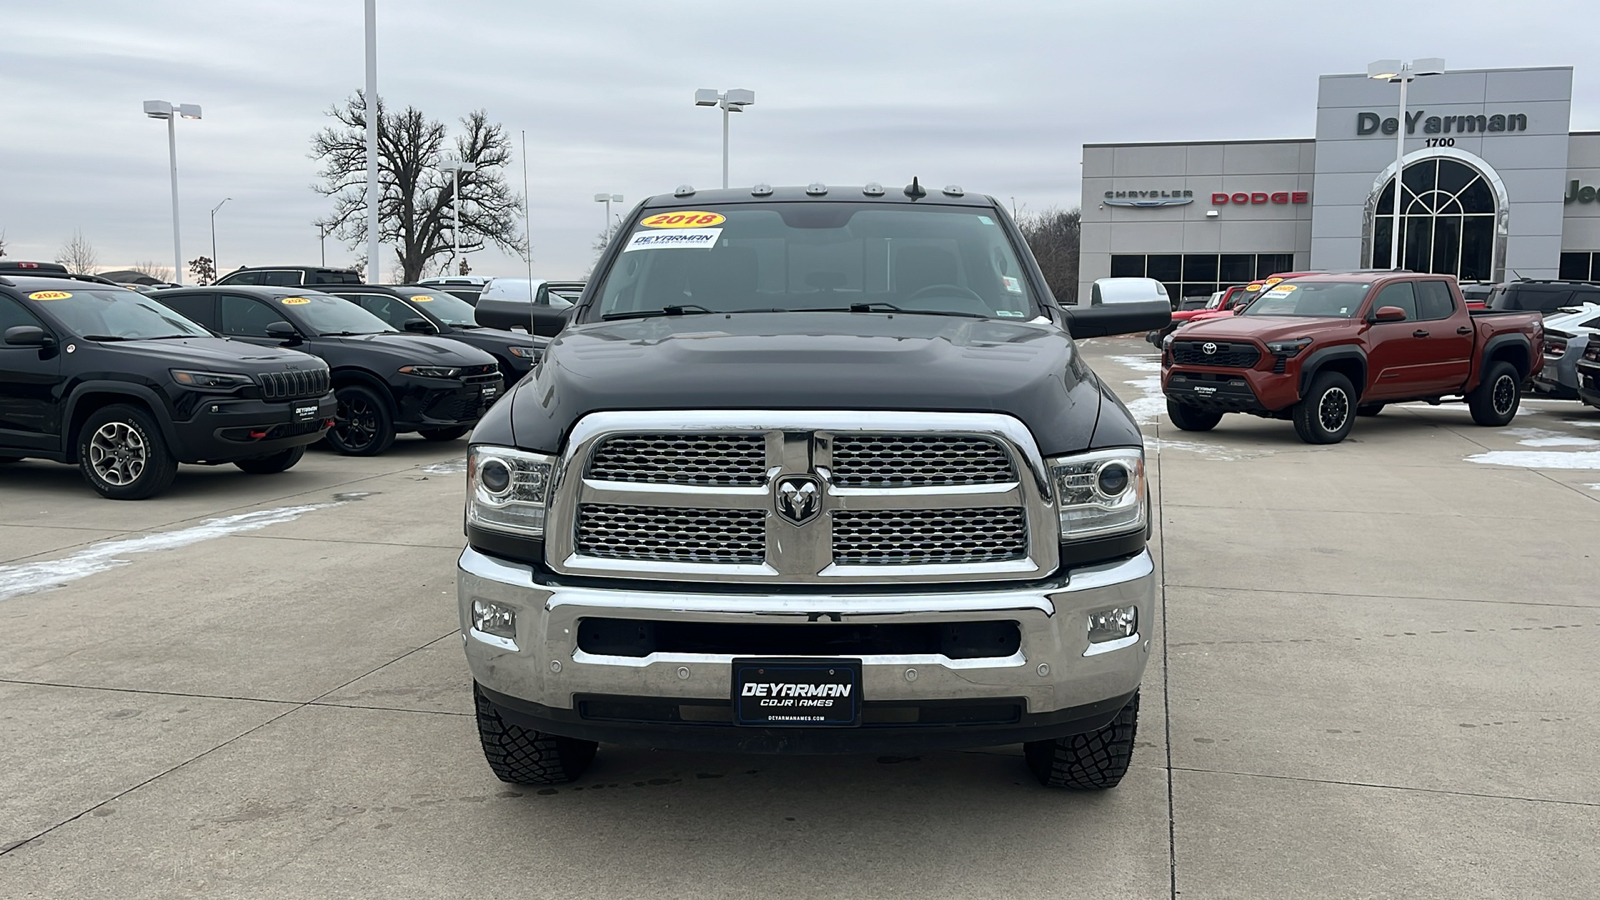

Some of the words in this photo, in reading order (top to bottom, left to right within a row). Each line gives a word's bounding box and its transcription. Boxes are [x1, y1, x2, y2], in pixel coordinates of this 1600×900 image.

[1356, 110, 1528, 136] DeYarman
[1425, 137, 1455, 147] 1700
[1104, 190, 1193, 199] CHRYSLER
[1211, 191, 1309, 205] DODGE
[647, 214, 718, 225] 2018
[634, 234, 714, 244] DEYARMAN
[741, 682, 852, 697] DEYARMAN
[760, 698, 794, 707] CDJR
[798, 699, 834, 707] AMES
